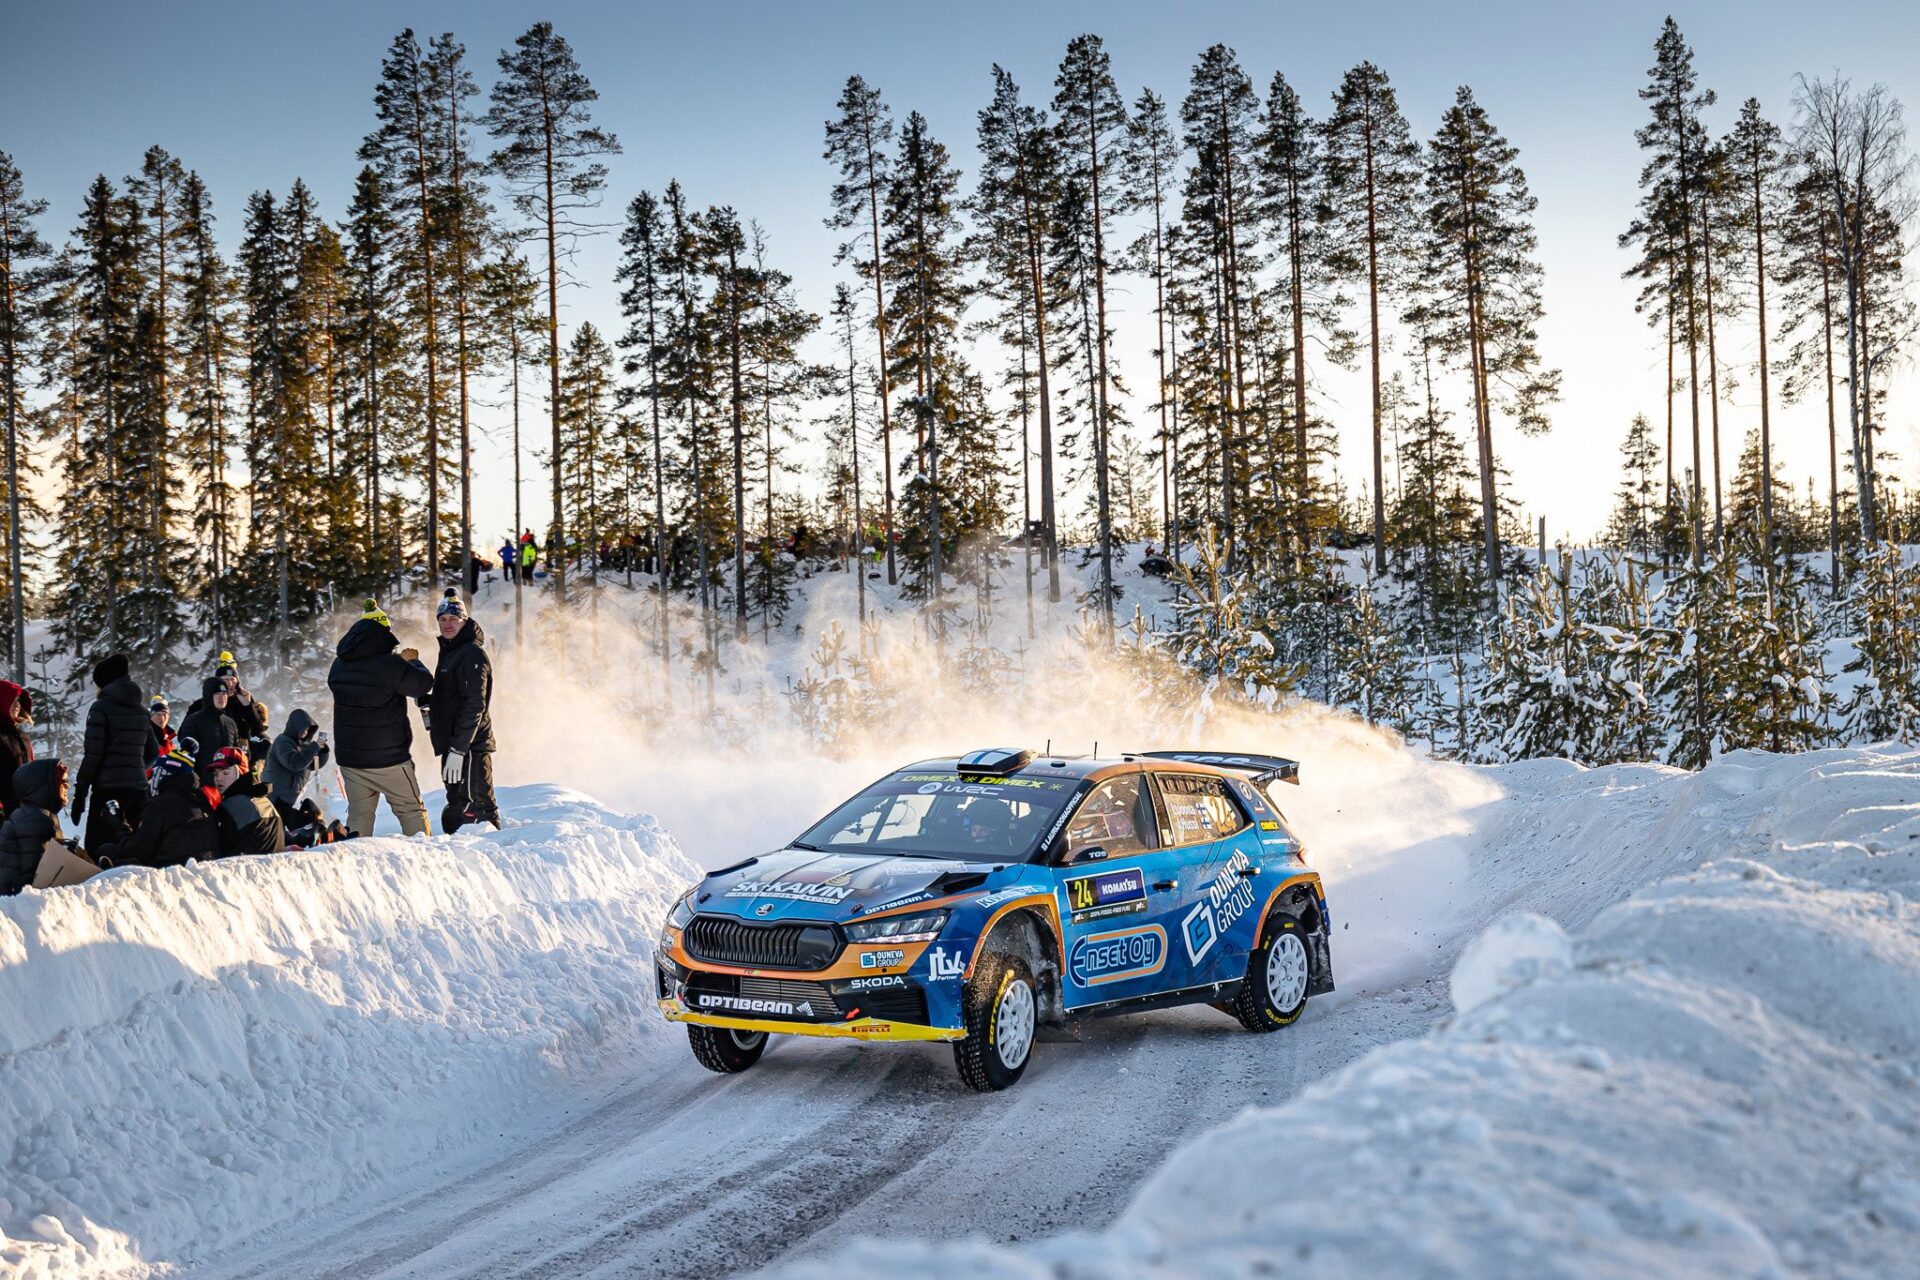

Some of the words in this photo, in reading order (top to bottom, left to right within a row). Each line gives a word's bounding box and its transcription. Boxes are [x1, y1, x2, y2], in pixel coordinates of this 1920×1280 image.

[901, 774, 957, 782] DIMEX
[978, 776, 1047, 789] DIMEX
[943, 784, 1004, 796] WRC
[1088, 851, 1107, 859] TGS
[1074, 879, 1093, 909] 24
[1101, 878, 1137, 895] KOMATSU
[865, 895, 922, 914] OPTIBEAM
[1216, 878, 1256, 933] GROUP
[1129, 935, 1155, 967] Oy
[876, 958, 900, 967] GROUP
[699, 994, 793, 1015] OPTIBEAM
